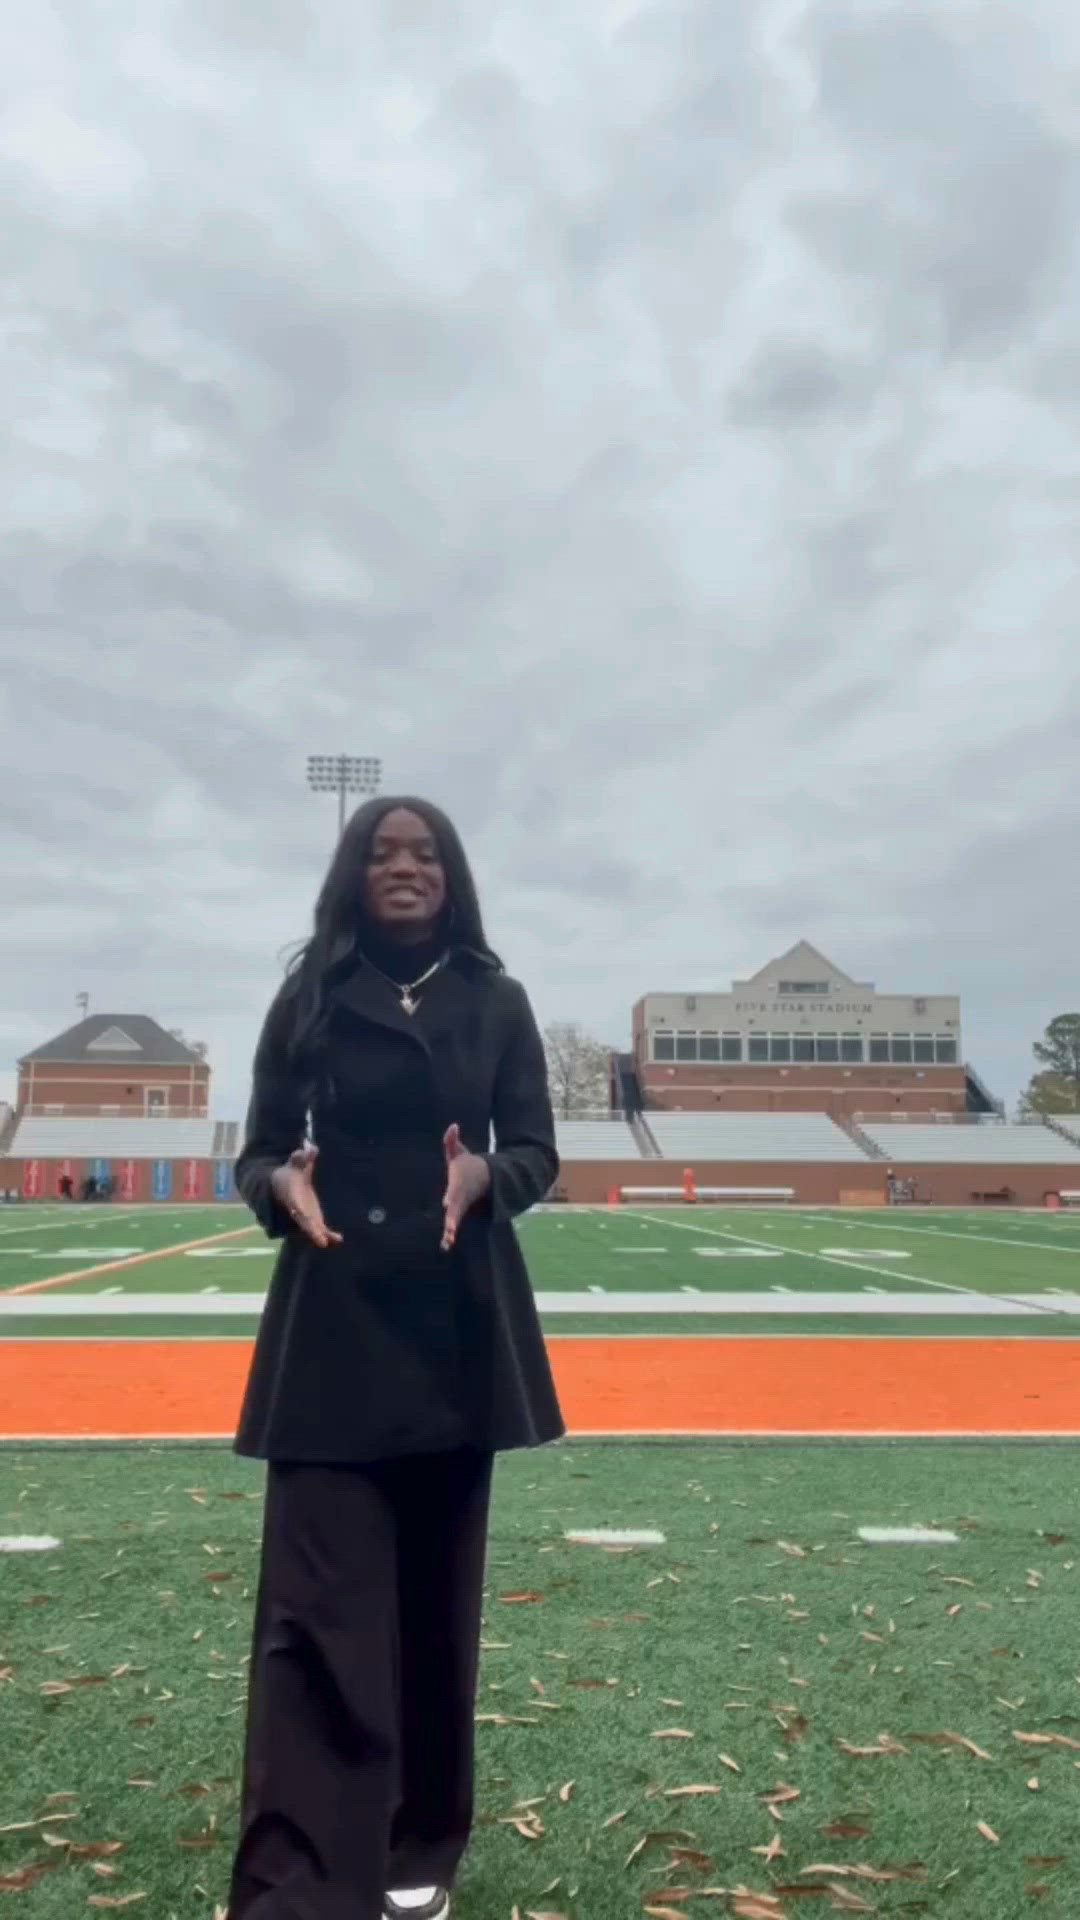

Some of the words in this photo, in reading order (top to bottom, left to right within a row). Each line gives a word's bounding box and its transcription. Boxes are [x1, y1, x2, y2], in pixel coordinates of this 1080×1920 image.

[735, 1003, 767, 1013] FIVE
[771, 1003, 805, 1013] STAR
[809, 1003, 873, 1013] STADIUM
